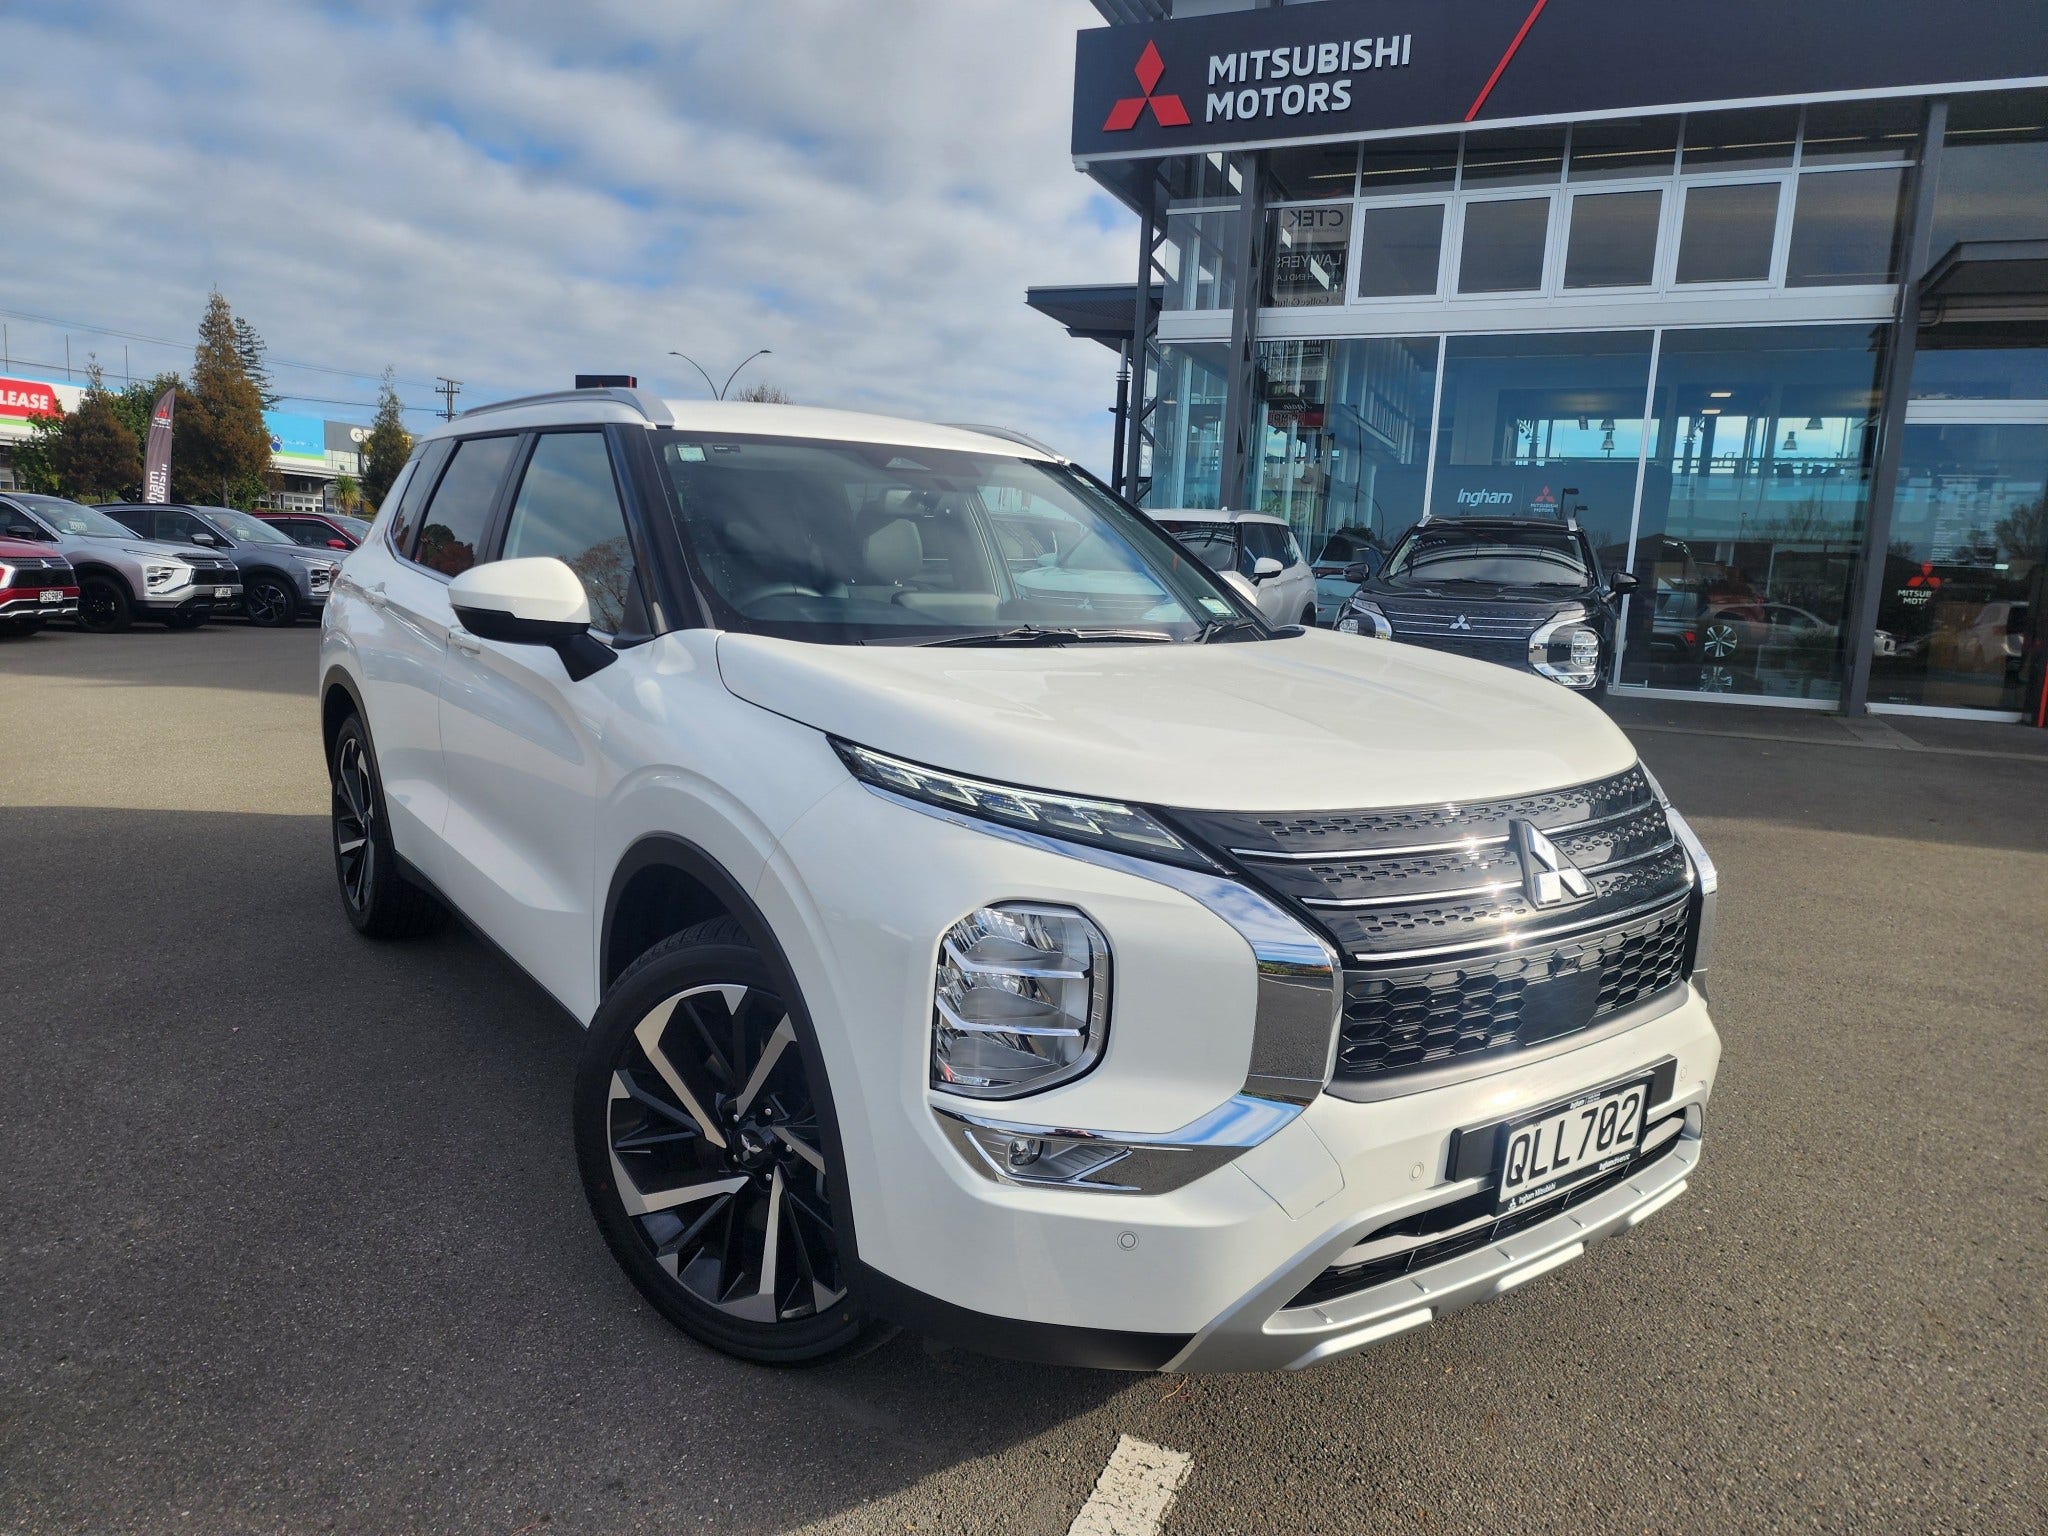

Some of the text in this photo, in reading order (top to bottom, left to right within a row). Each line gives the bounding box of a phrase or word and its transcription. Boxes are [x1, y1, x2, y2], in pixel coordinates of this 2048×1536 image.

[1208, 34, 1412, 86] MITSUBISHI
[1205, 79, 1352, 123] MOTORS
[0, 390, 48, 410] LEASE
[1457, 488, 1513, 506] Ingham
[1506, 1092, 1640, 1188] QLL702
